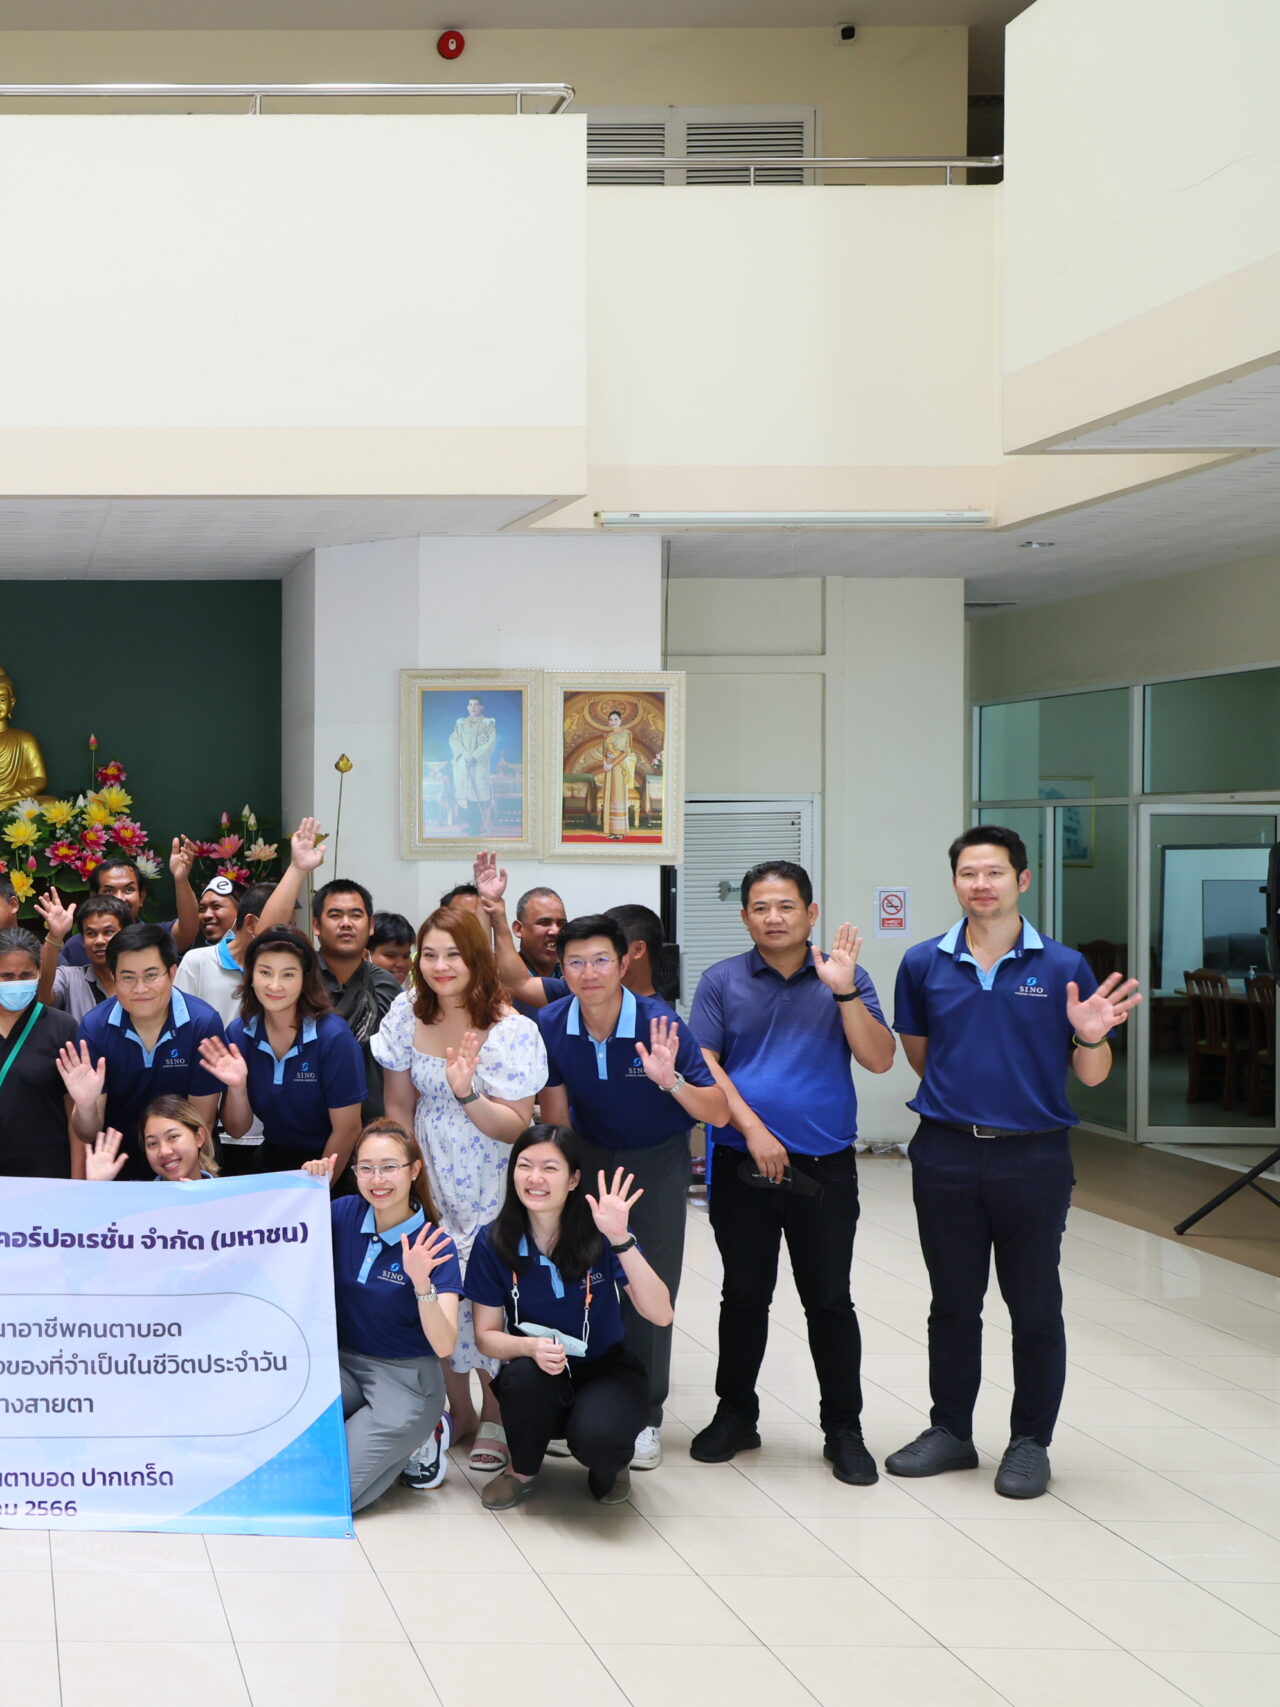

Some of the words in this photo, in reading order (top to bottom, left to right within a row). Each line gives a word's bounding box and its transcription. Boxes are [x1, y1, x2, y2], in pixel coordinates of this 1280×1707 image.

[1019, 985, 1044, 993] SINO
[141, 1227, 205, 1250] จำกัด
[211, 1221, 309, 1252] (มหาชน)
[381, 1270, 404, 1281] SINO
[582, 1272, 602, 1285] SNO
[82, 1463, 174, 1488] ปากเกร็ด
[25, 1500, 78, 1517] 2566
